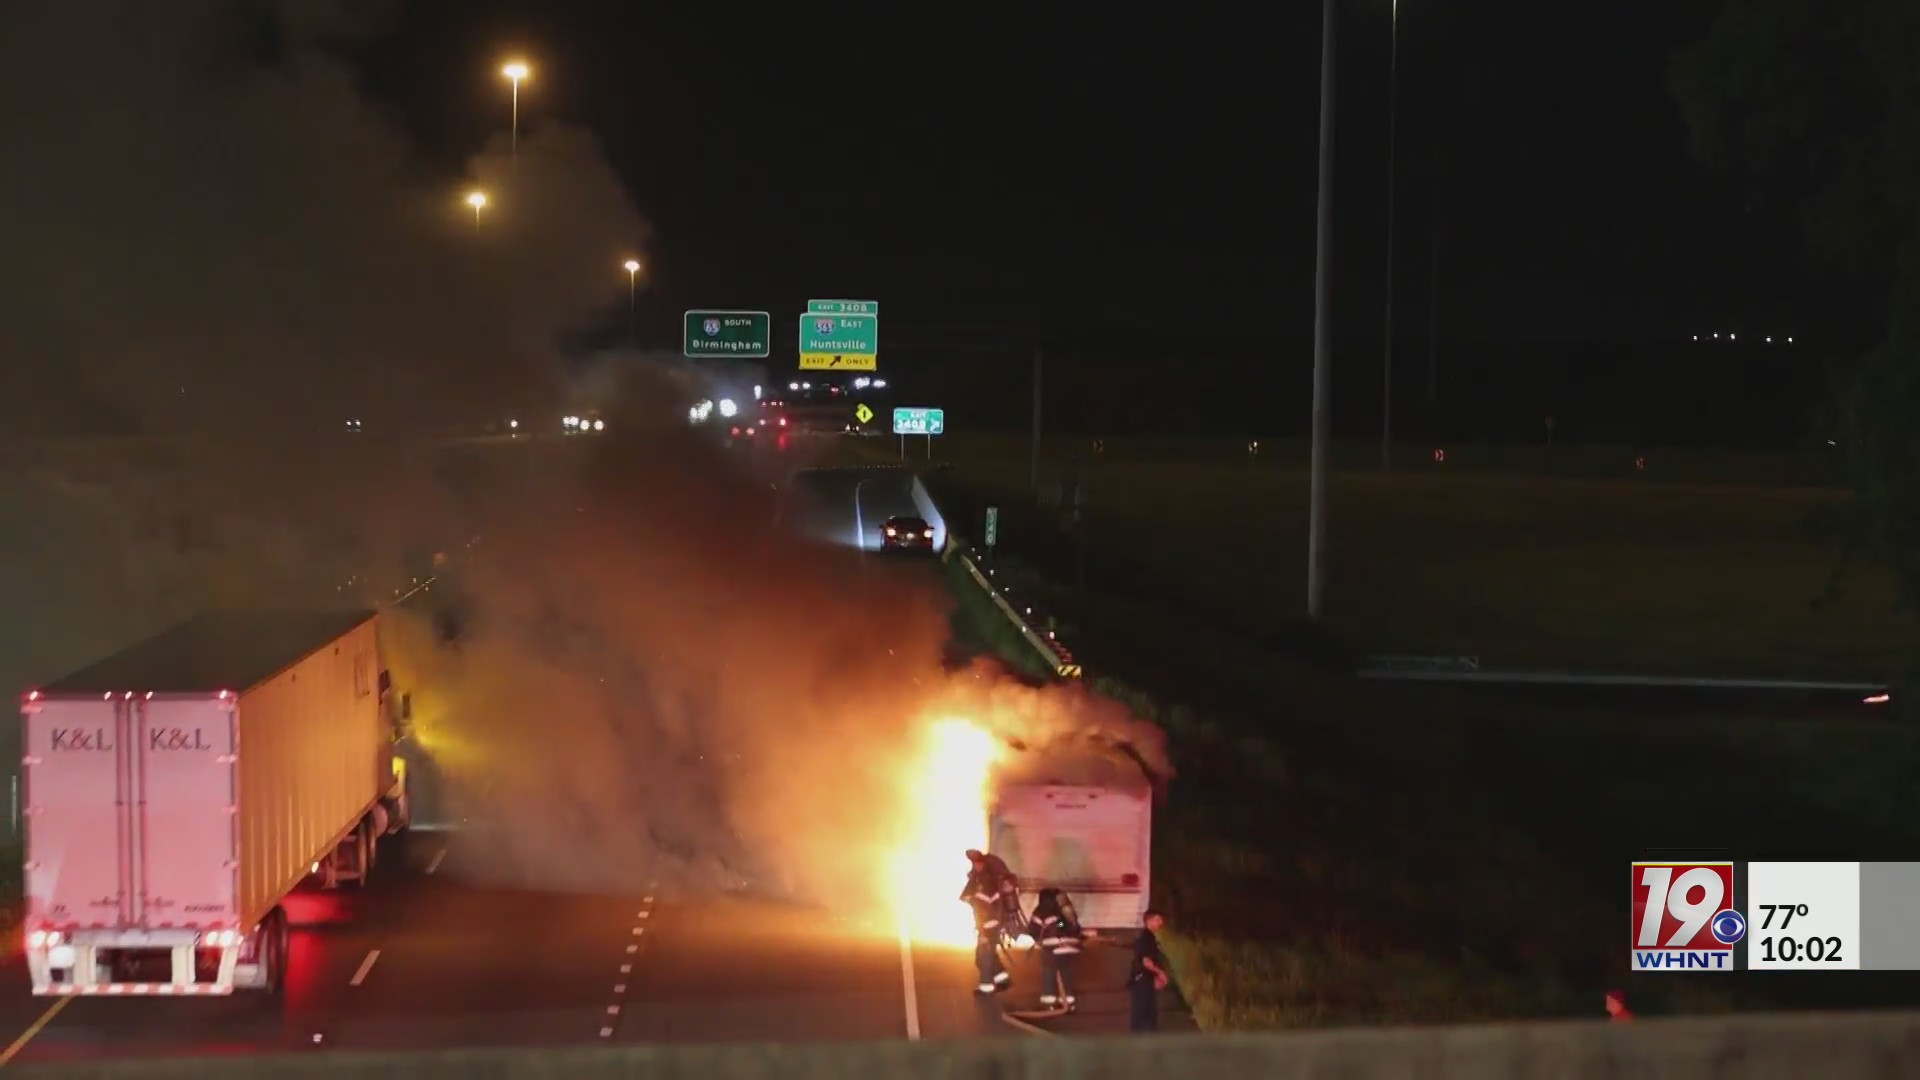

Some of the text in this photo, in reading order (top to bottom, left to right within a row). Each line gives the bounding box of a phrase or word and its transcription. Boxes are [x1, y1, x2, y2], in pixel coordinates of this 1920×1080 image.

[692, 339, 762, 351] Birmingham
[810, 340, 866, 350] Huntsville
[51, 728, 113, 751] K&L
[150, 728, 212, 751] K&L
